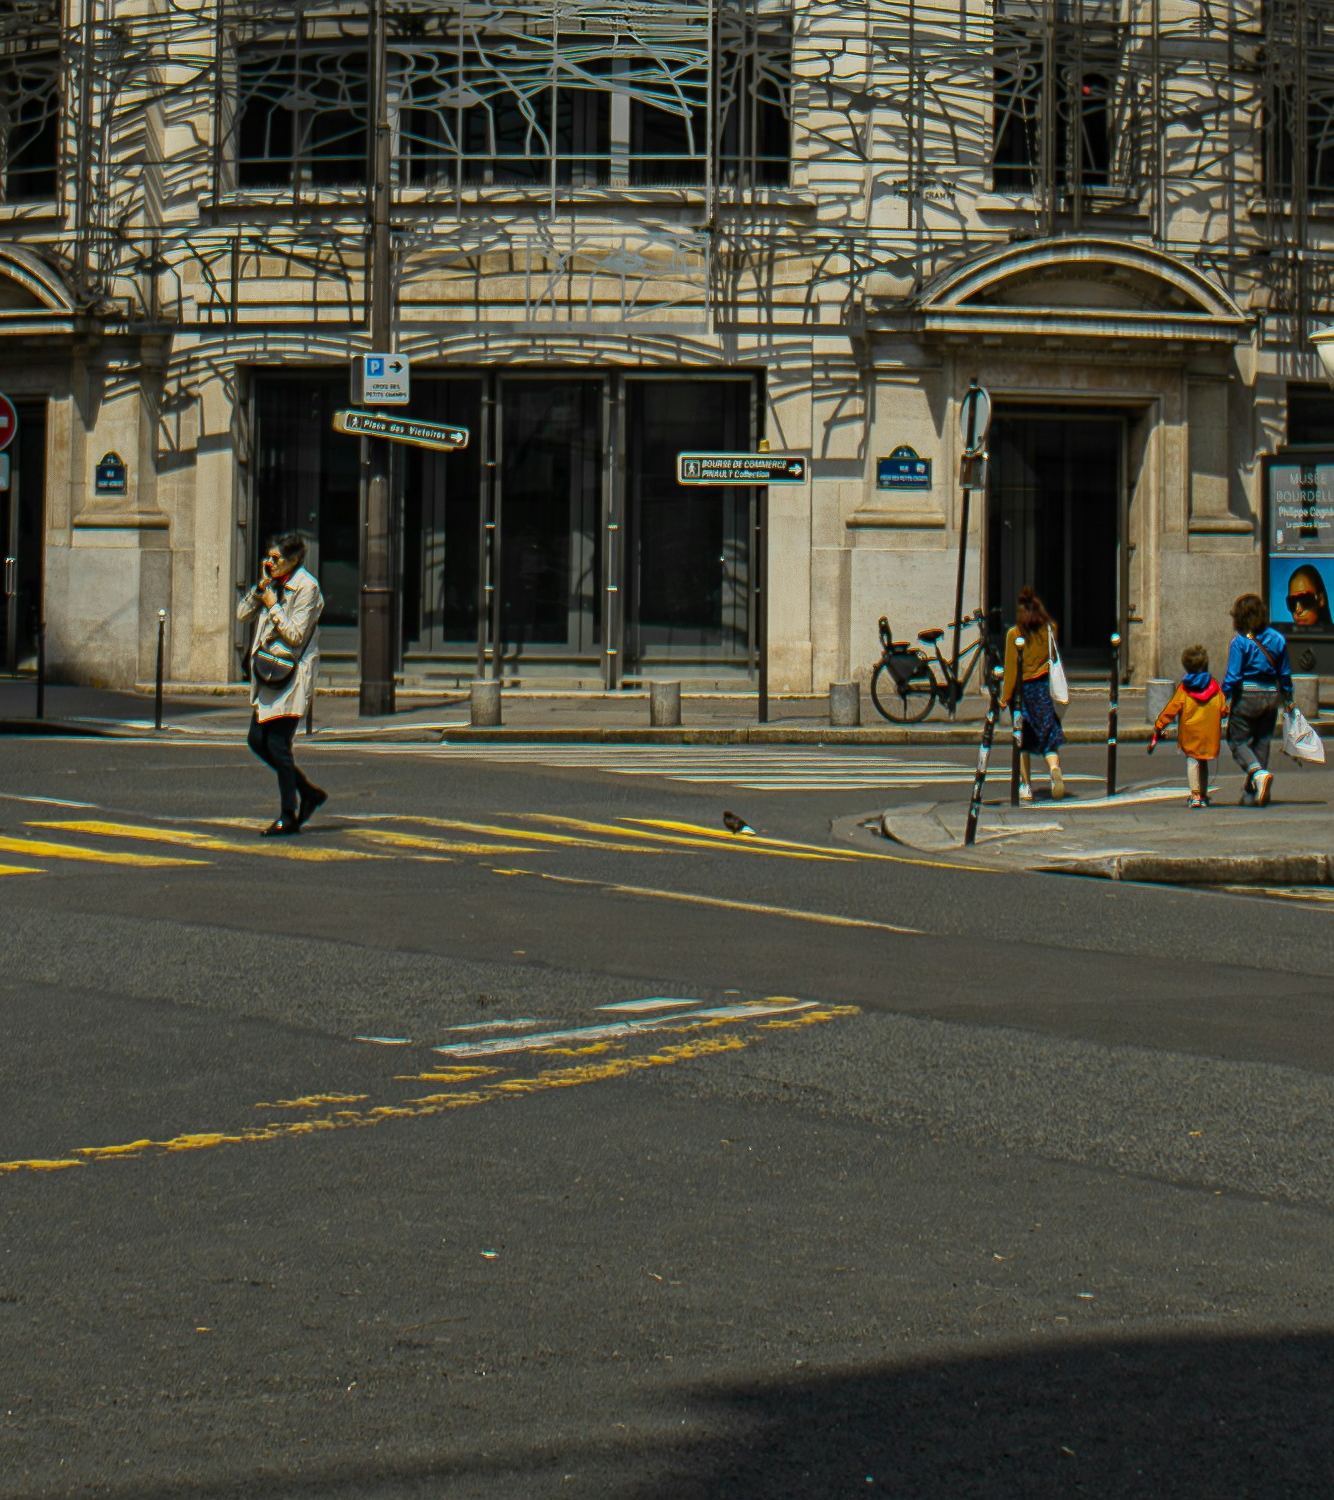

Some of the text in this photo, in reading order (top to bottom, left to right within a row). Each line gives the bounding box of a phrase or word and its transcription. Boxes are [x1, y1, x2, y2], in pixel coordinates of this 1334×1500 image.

[363, 418, 446, 440] Place des Victoires
[701, 459, 787, 470] BOURSE DE COMMERCE
[701, 469, 770, 479] PINAULT Collection
